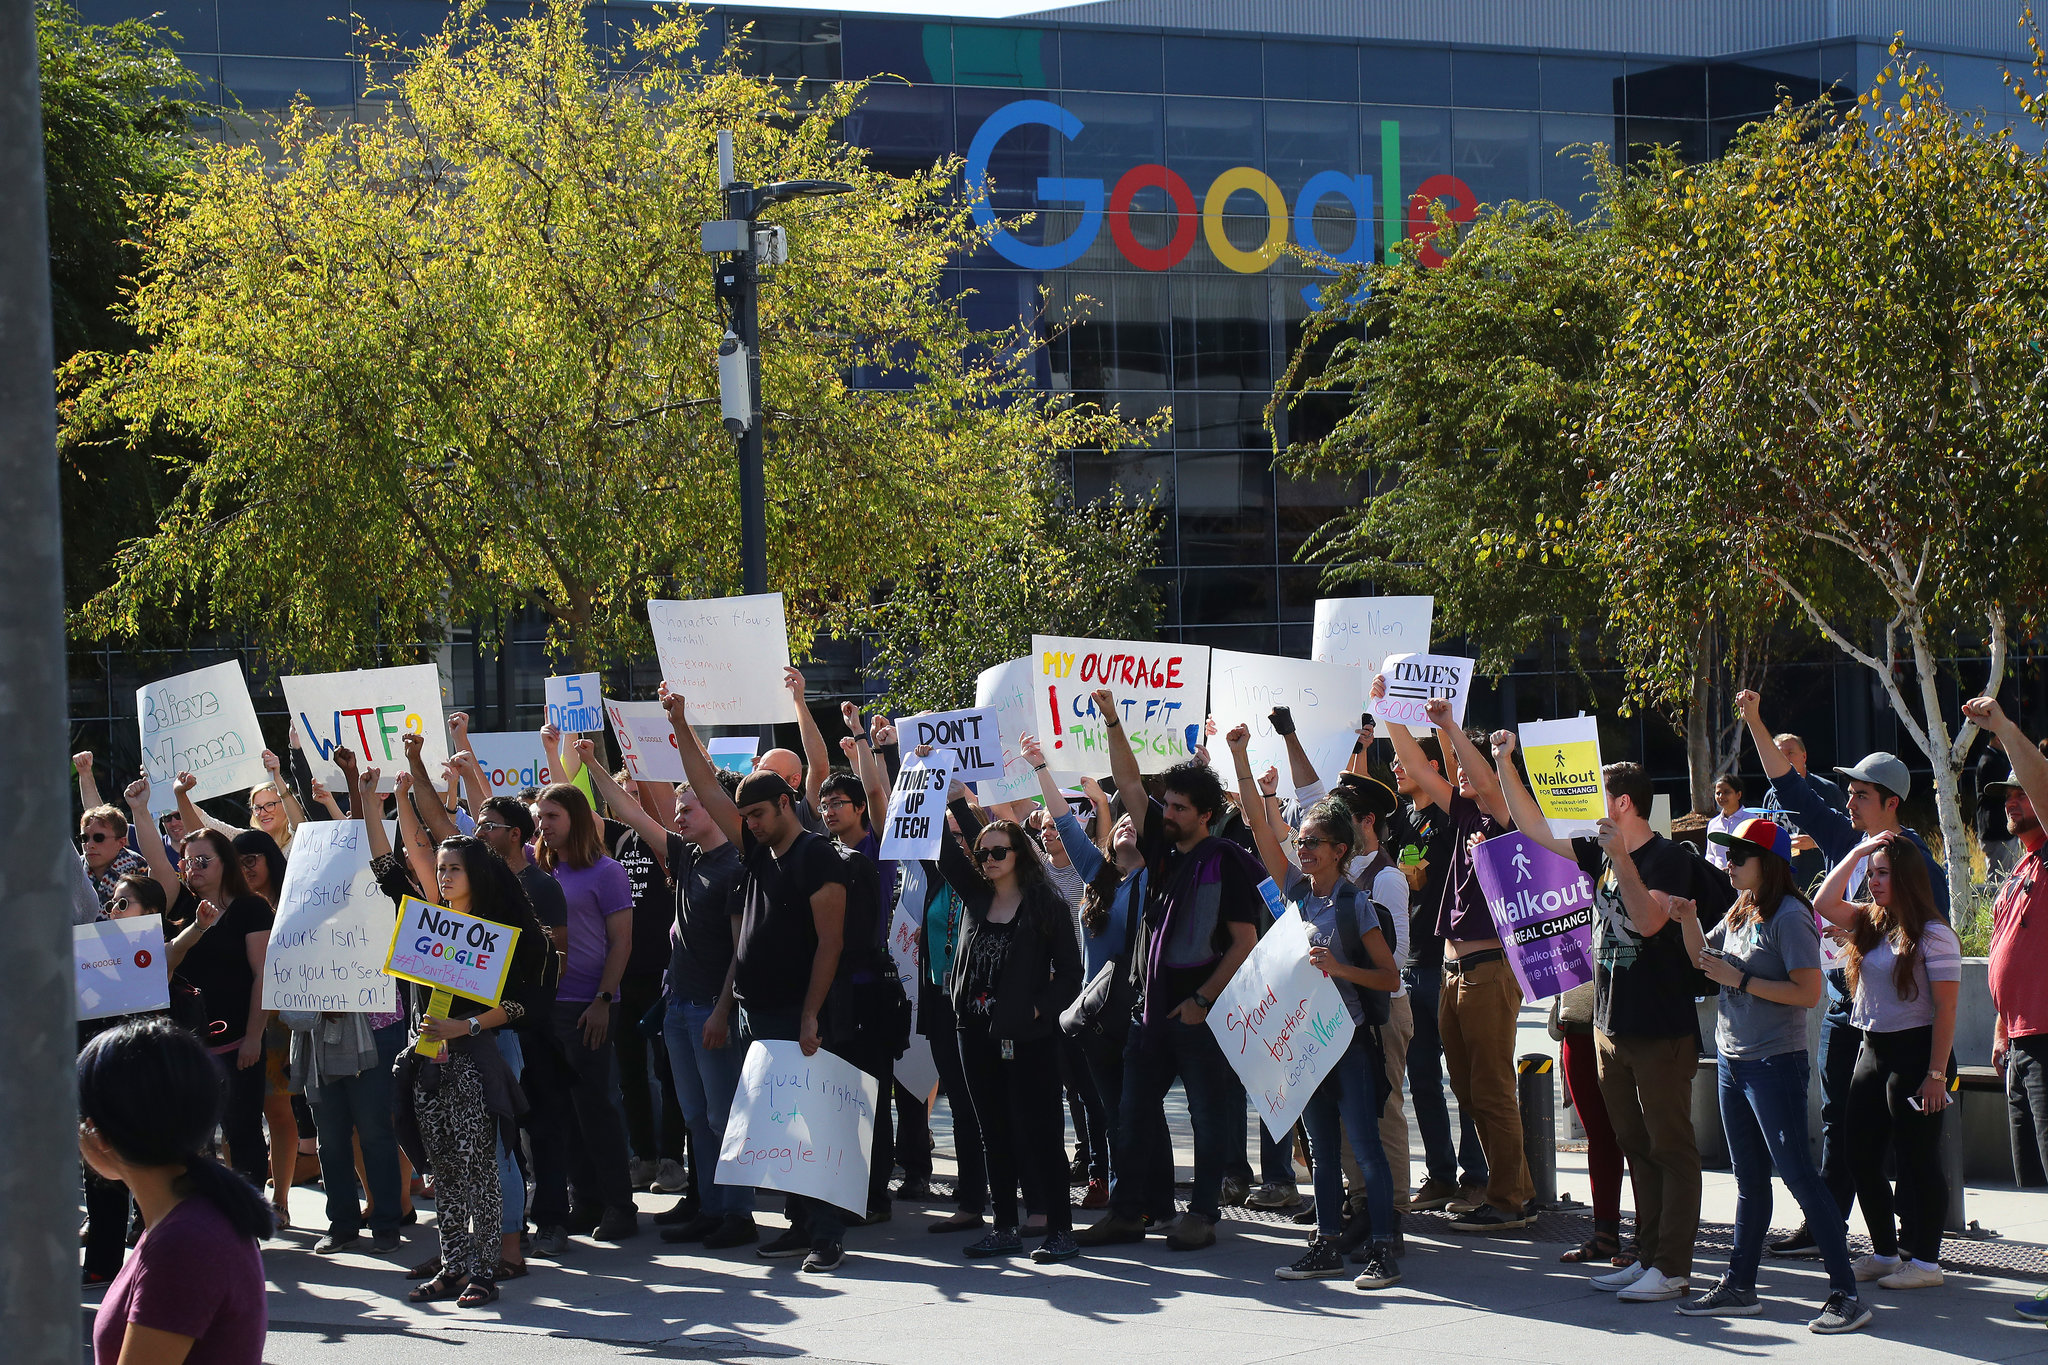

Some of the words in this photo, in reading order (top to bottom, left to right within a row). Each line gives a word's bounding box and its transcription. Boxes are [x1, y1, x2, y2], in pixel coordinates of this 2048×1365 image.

[964, 99, 1479, 320] Google
[655, 606, 719, 629] Character
[1367, 609, 1404, 638] Men
[668, 673, 708, 689] Android
[1042, 650, 1076, 679] MY
[1080, 652, 1185, 689] OUTRAGE
[1393, 662, 1462, 686] TIME'S
[565, 675, 584, 707] 5
[1224, 665, 1285, 709] Time
[143, 688, 220, 734] Believe
[548, 703, 603, 732] DEMANDS
[686, 696, 744, 714] anagement!
[300, 703, 424, 762] WTF?
[608, 706, 639, 775] NOT
[645, 736, 663, 744] GOOGLE
[917, 715, 983, 747] DON'T
[142, 731, 246, 785] Women
[897, 767, 946, 792] TIME'S
[1533, 769, 1596, 786] Walkout
[1551, 788, 1567, 796] REAL
[1566, 785, 1597, 795] CHANGE
[904, 792, 925, 816] UP
[893, 816, 930, 840] TECH
[298, 829, 324, 871] My
[330, 826, 359, 851] Red
[288, 875, 353, 913] Lipstick
[1490, 875, 1593, 927] Walkout
[276, 928, 318, 950] work
[414, 935, 491, 970] GOOGLE
[466, 922, 500, 953] OK
[1504, 932, 1517, 949] FOR
[1515, 926, 1541, 944] REAL
[80, 961, 92, 971] OK
[92, 957, 122, 969] GOOGLE
[273, 957, 292, 985] for
[299, 963, 324, 993] you
[331, 959, 349, 981] to
[1543, 957, 1583, 978] 11:10am
[273, 990, 350, 1011] comment
[1226, 983, 1278, 1055] Stand
[1262, 998, 1309, 1063] together
[1264, 1084, 1289, 1118] for
[1284, 1042, 1320, 1088] Google
[1304, 1002, 1348, 1048] Women
[770, 1102, 804, 1124] at
[821, 1079, 867, 1117] rights
[736, 1136, 817, 1173] Google
